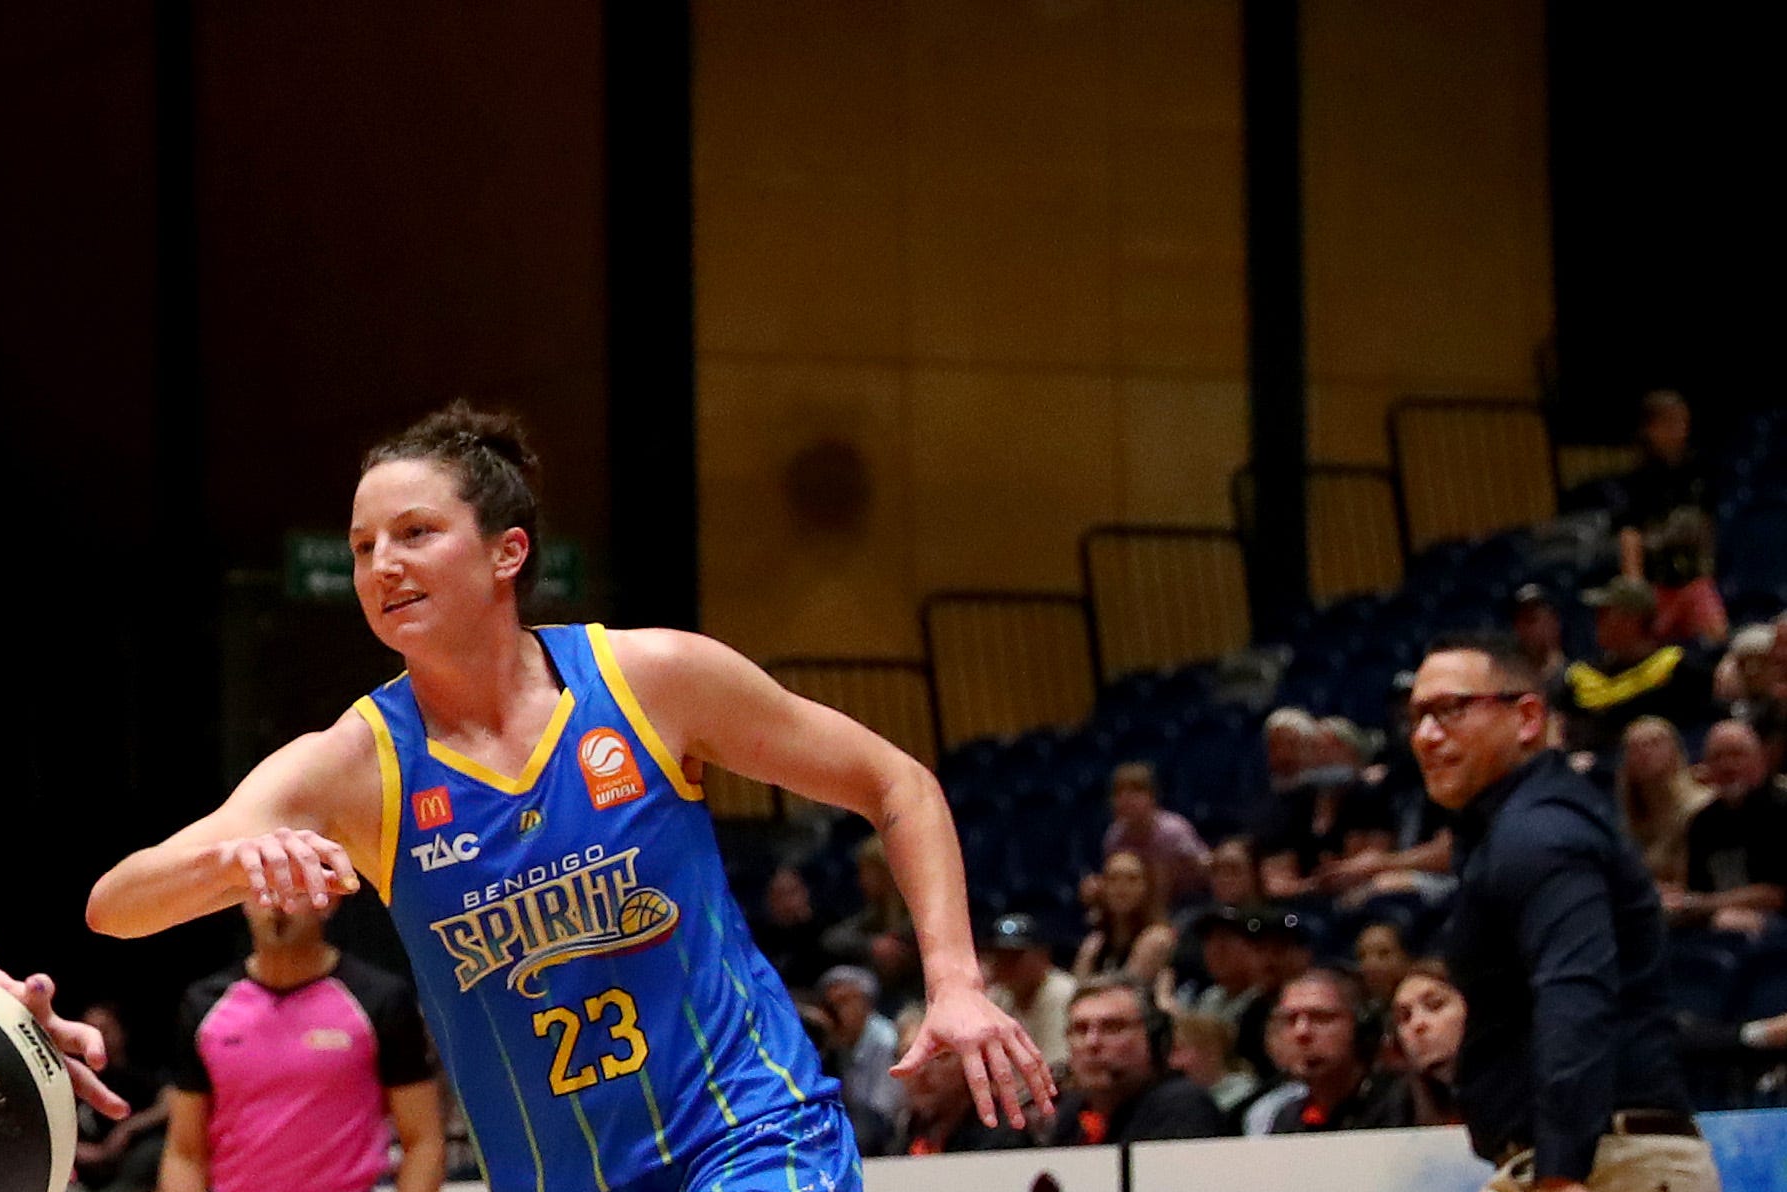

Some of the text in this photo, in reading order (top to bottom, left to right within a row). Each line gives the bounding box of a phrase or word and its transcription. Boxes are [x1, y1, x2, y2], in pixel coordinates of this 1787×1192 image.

[596, 783, 639, 805] WNBL
[411, 832, 480, 873] TAC
[463, 843, 604, 910] BENDIGO
[429, 846, 641, 994] SPIRIT
[532, 987, 650, 1097] 23
